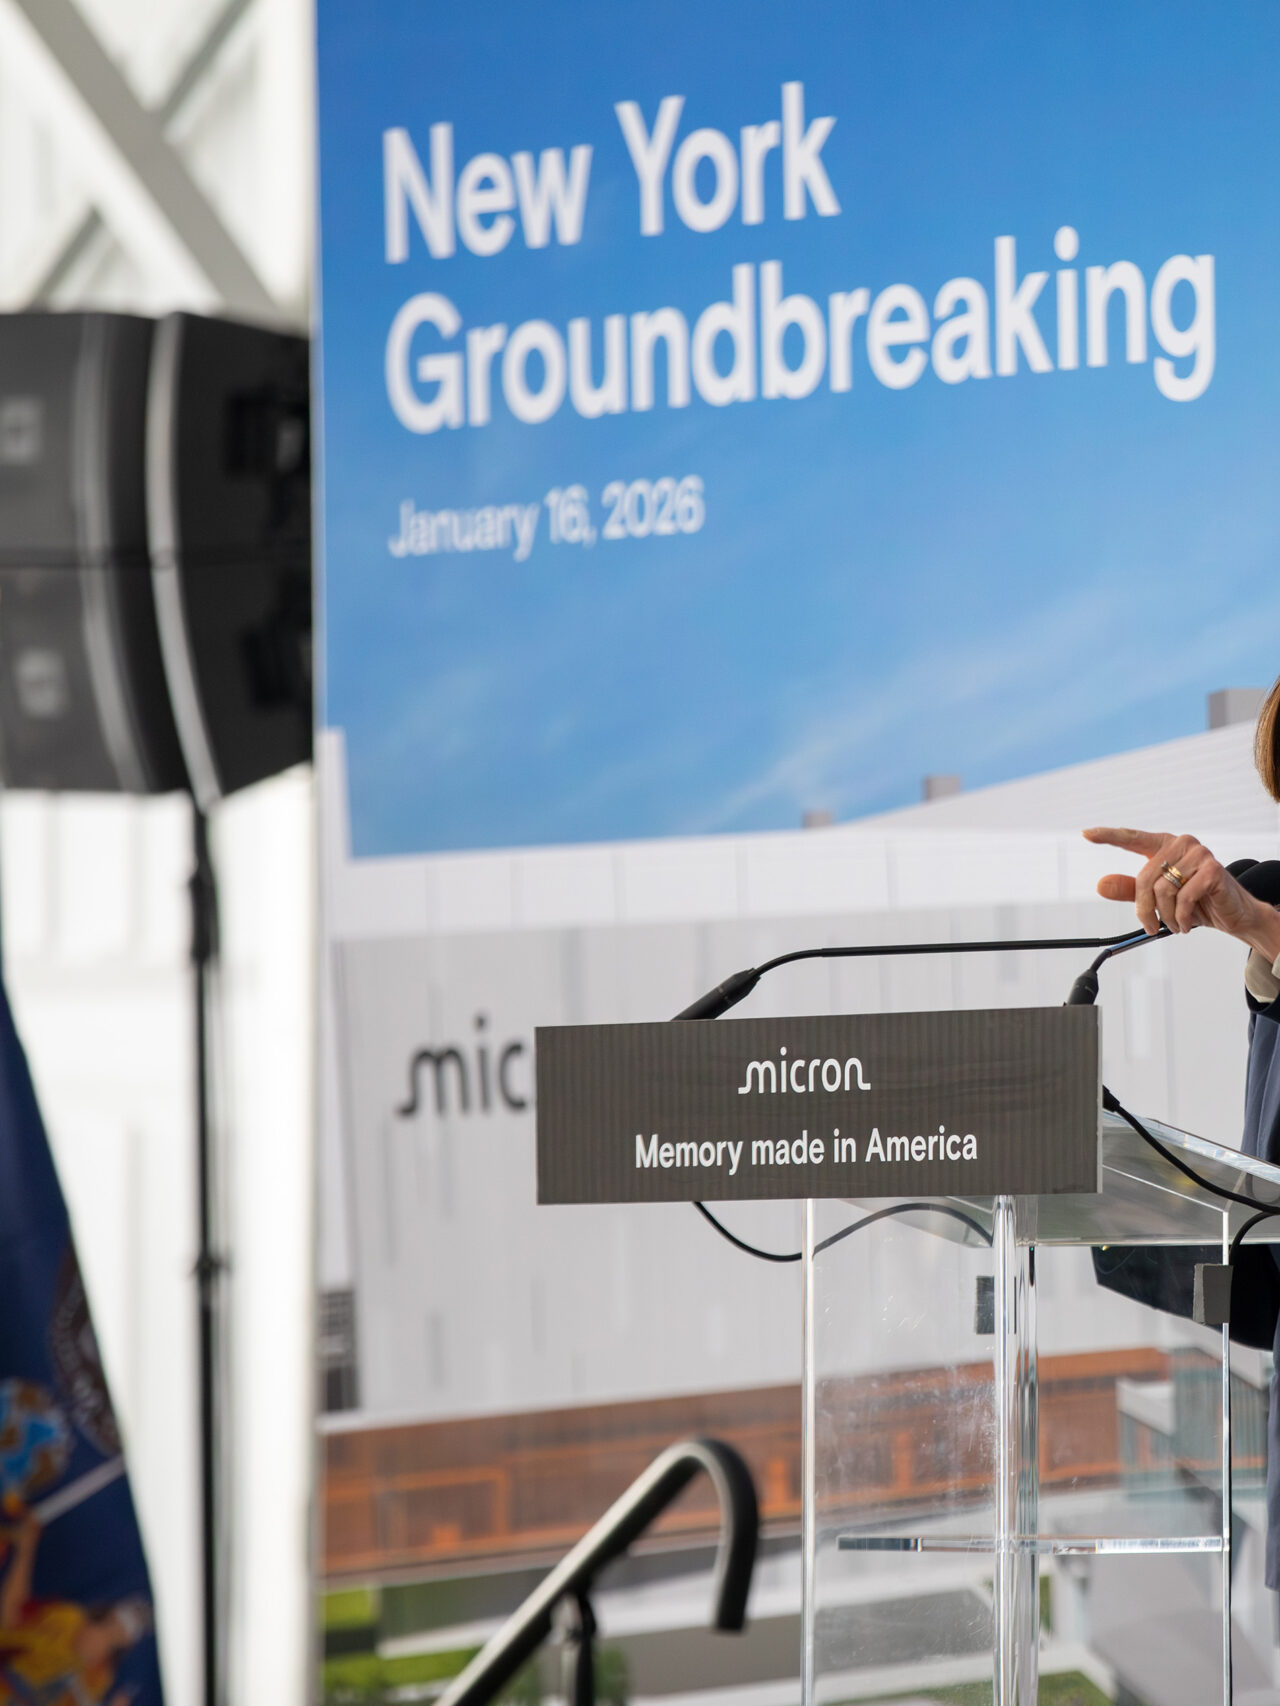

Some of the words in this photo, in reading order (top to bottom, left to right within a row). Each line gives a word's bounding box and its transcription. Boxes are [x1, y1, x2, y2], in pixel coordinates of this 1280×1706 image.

[383, 121, 593, 264] New
[614, 80, 841, 237] York
[384, 225, 1216, 435] Groundbreaking
[388, 498, 540, 562] January
[543, 484, 597, 548] 16,
[602, 475, 706, 539] 2026
[396, 1013, 533, 1117] mic
[738, 1046, 871, 1095] micron
[635, 1133, 744, 1176] Memory
[751, 1129, 825, 1166] made
[833, 1128, 857, 1163] in
[865, 1124, 978, 1163] America
